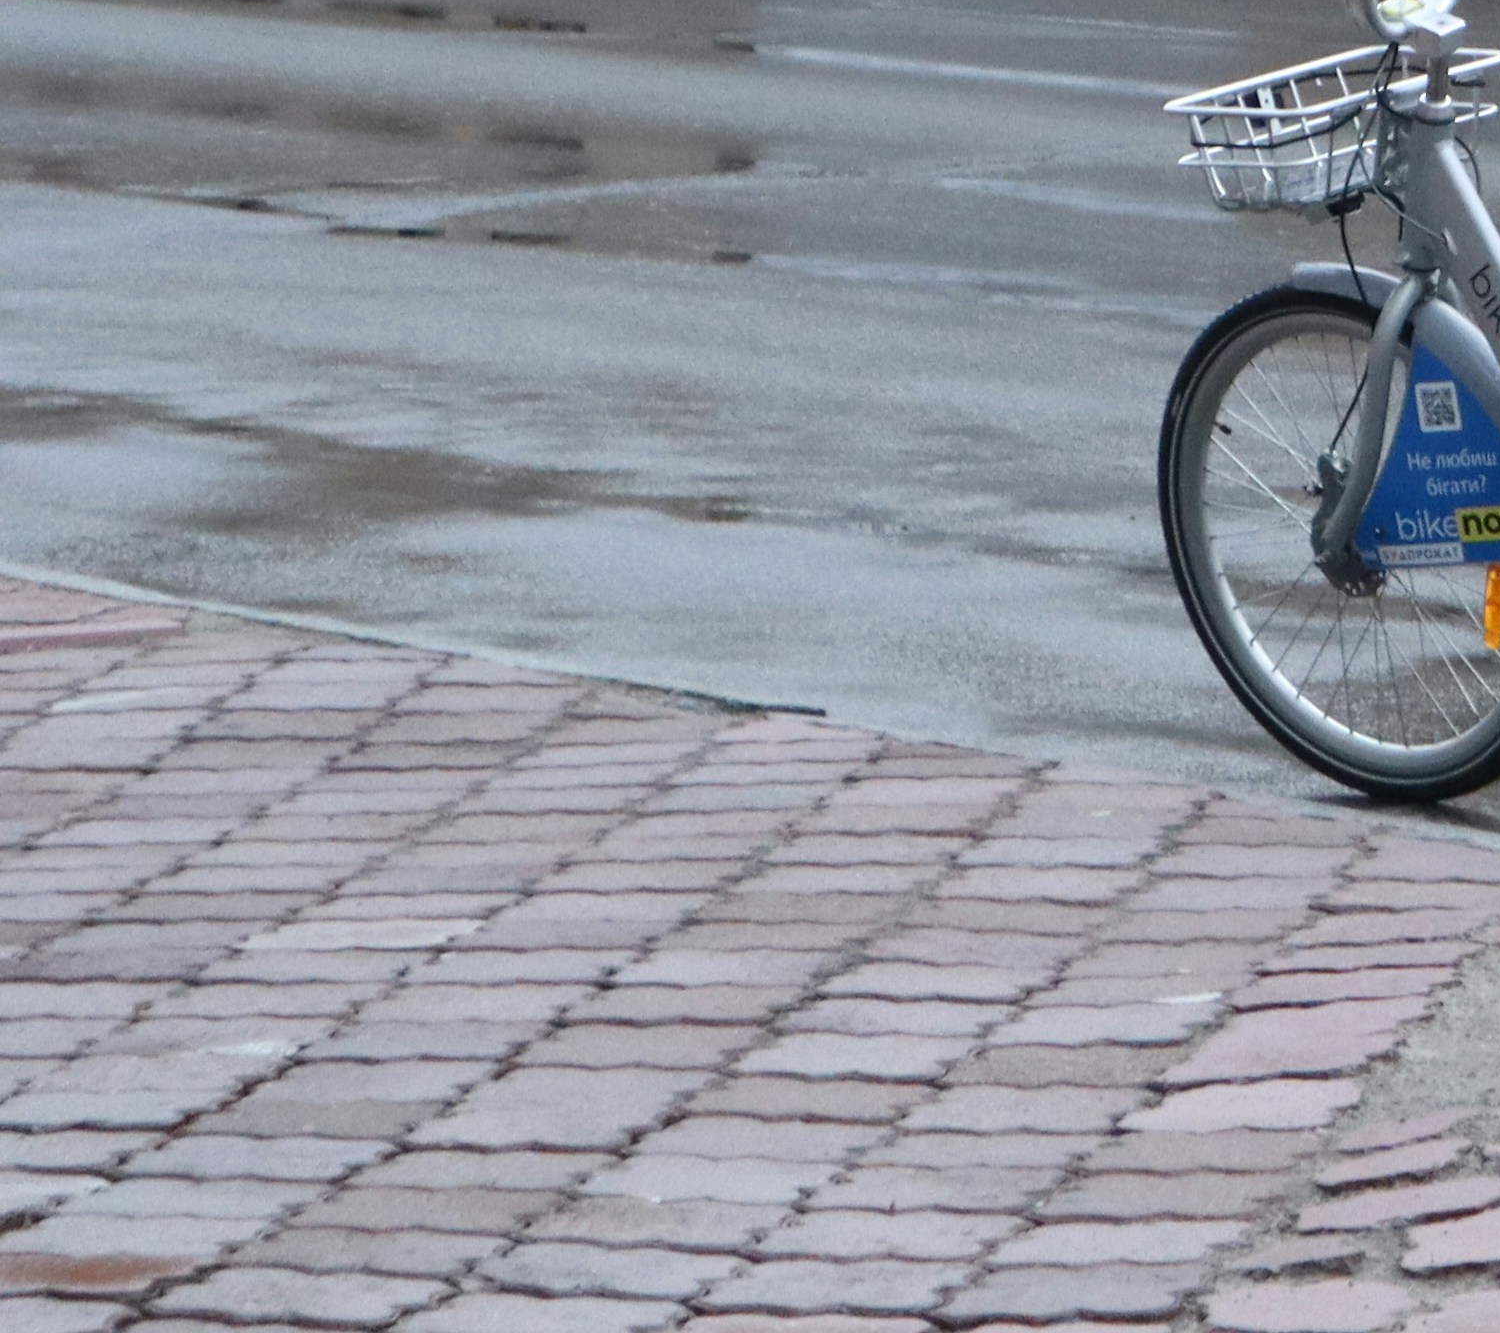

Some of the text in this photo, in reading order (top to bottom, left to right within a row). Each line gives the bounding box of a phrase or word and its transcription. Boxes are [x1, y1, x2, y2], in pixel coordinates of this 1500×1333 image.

[1407, 448, 1497, 470] Не любиш
[1426, 477, 1486, 497] бігати?
[1395, 509, 1458, 541] bike
